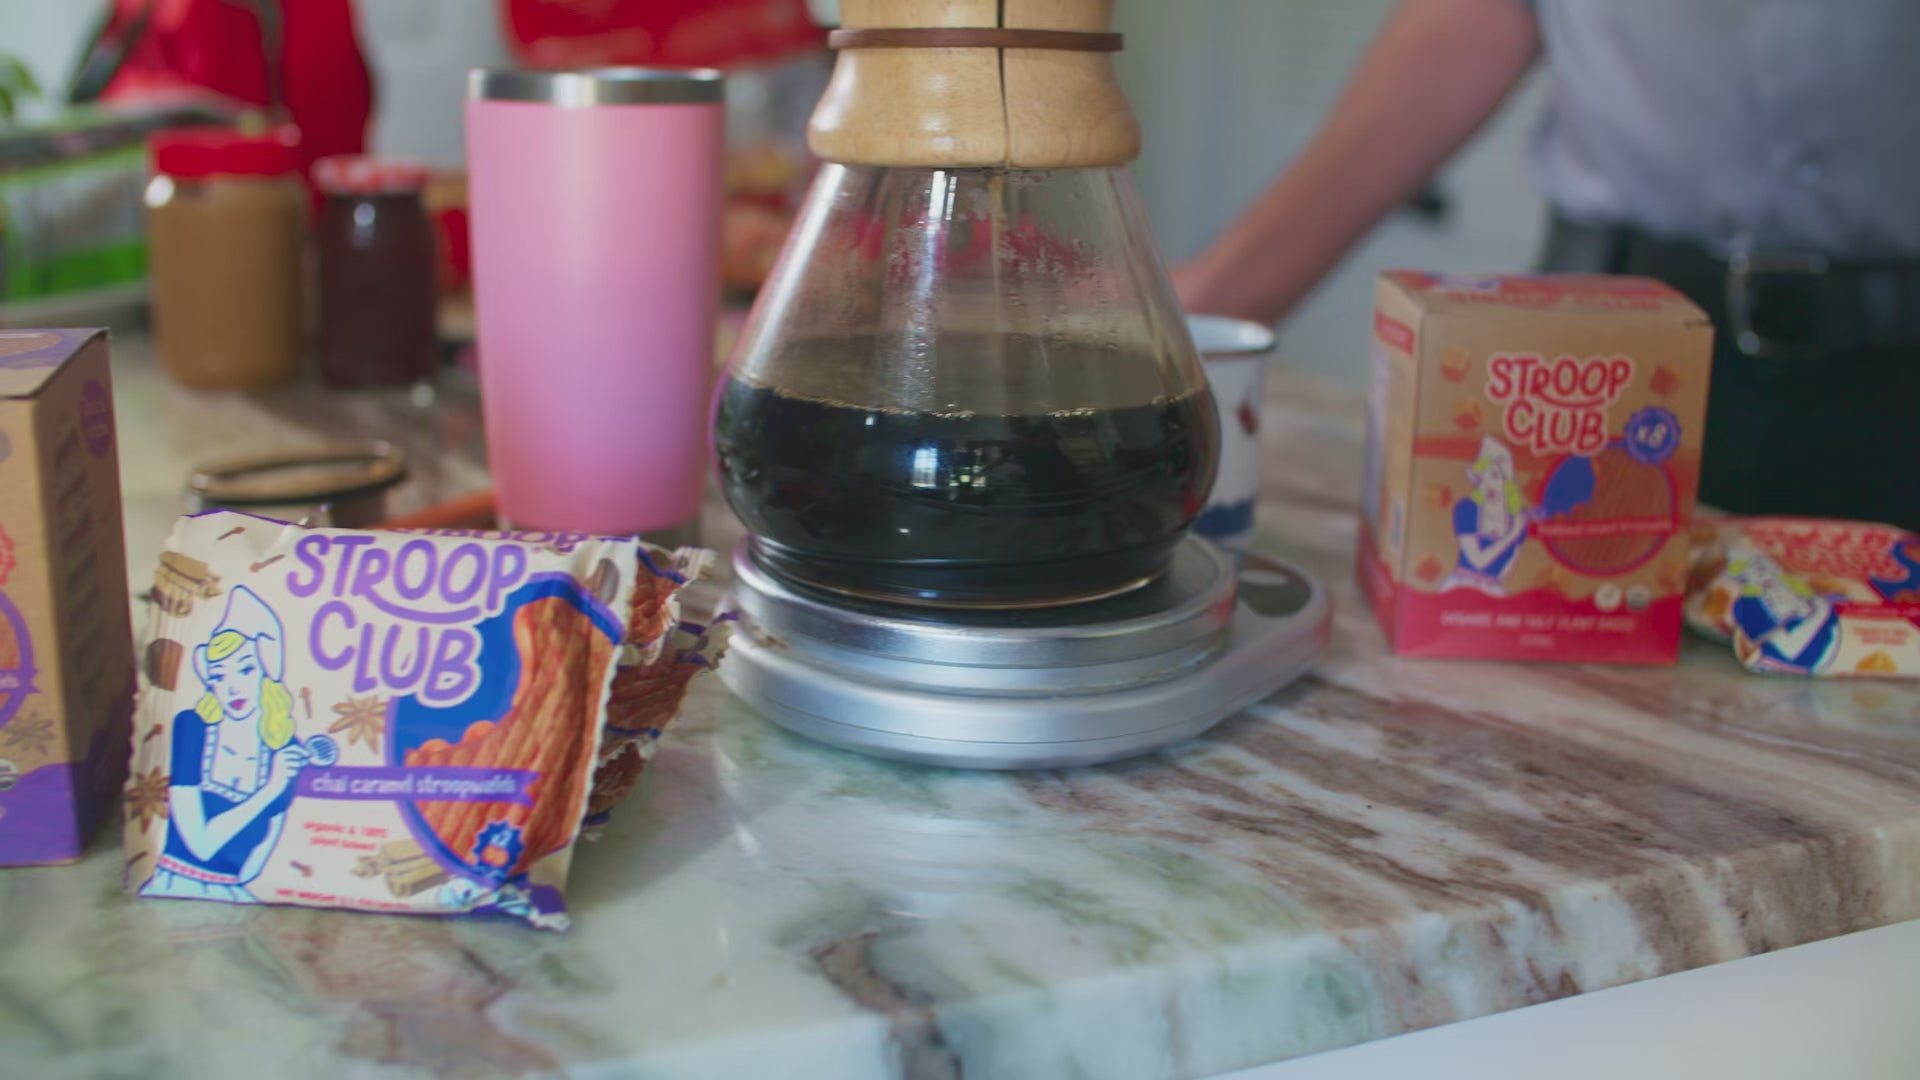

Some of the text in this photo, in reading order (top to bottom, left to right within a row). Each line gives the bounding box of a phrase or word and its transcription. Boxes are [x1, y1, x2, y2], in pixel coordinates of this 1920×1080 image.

[1489, 355, 1631, 409] STROOP
[1506, 400, 1604, 450] CLUB
[286, 534, 527, 624] STROOP
[309, 600, 477, 701] CLUB
